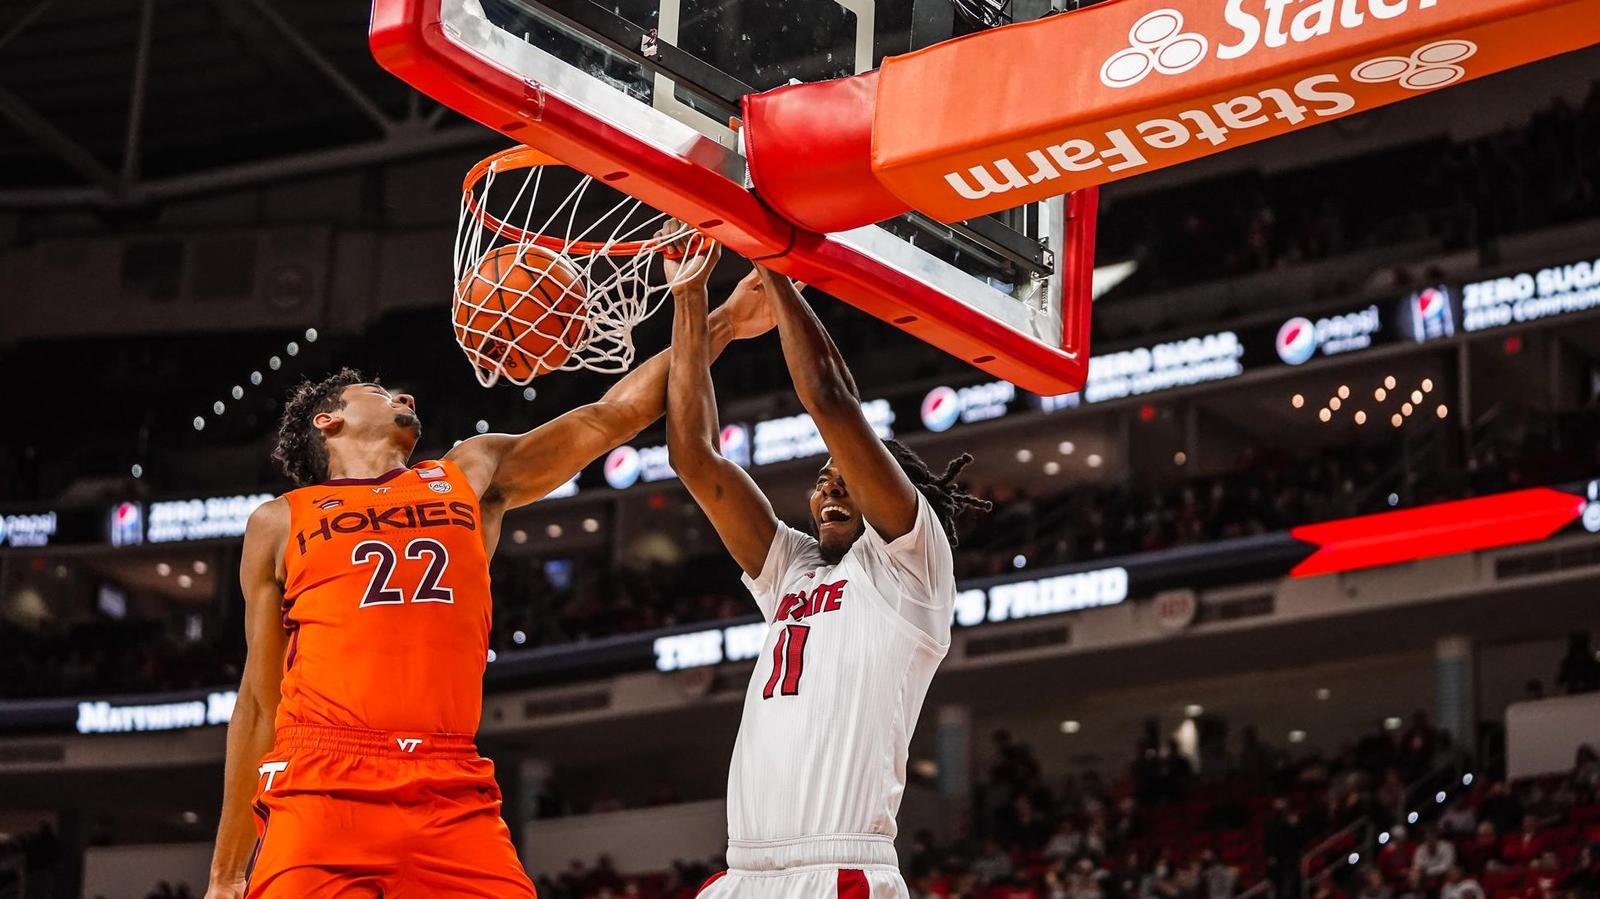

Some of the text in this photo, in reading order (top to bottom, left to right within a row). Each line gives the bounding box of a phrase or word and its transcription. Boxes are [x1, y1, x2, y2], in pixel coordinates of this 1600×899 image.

[944, 72, 1356, 200] StateFarm
[1463, 272, 1535, 311] ZERO
[296, 501, 476, 556] HOKIES
[351, 538, 454, 608] 22
[987, 566, 1128, 622] FRIEND
[762, 624, 811, 700] 11
[397, 737, 423, 753] VT
